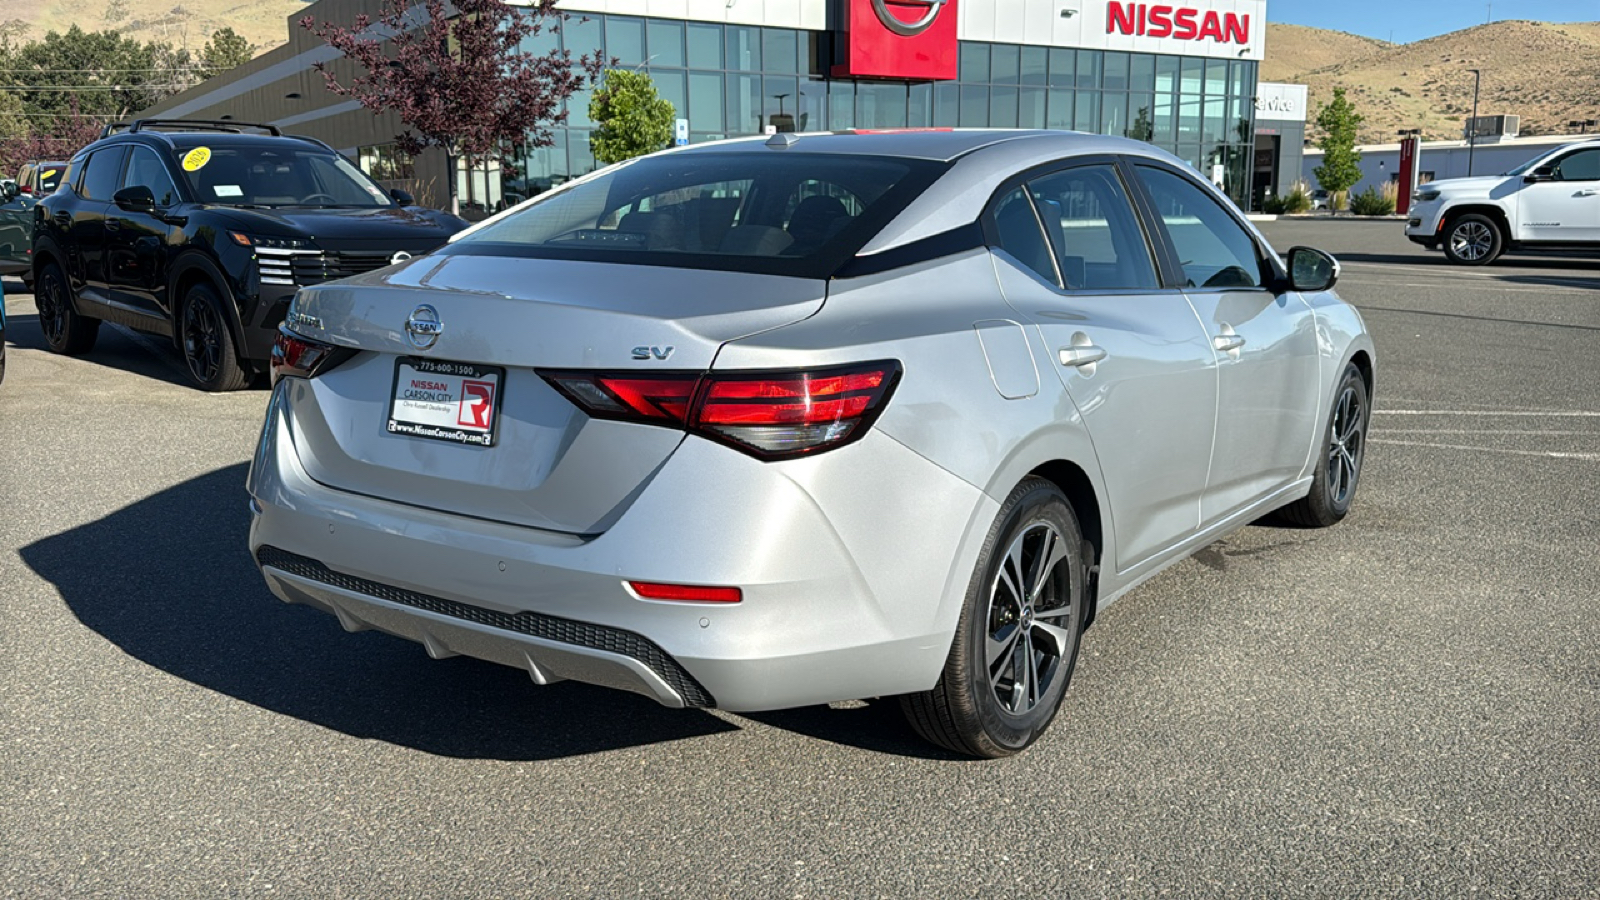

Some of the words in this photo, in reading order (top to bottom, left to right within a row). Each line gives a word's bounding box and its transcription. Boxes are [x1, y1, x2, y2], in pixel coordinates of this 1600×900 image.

[1107, 1, 1250, 44] NISSAN
[631, 345, 675, 360] SV
[420, 362, 474, 375] 775-600-1500
[411, 379, 448, 391] NISSAN
[404, 389, 436, 401] CARSON
[437, 393, 453, 403] CITY
[396, 424, 482, 443] www.NissanCarsonCity.com
